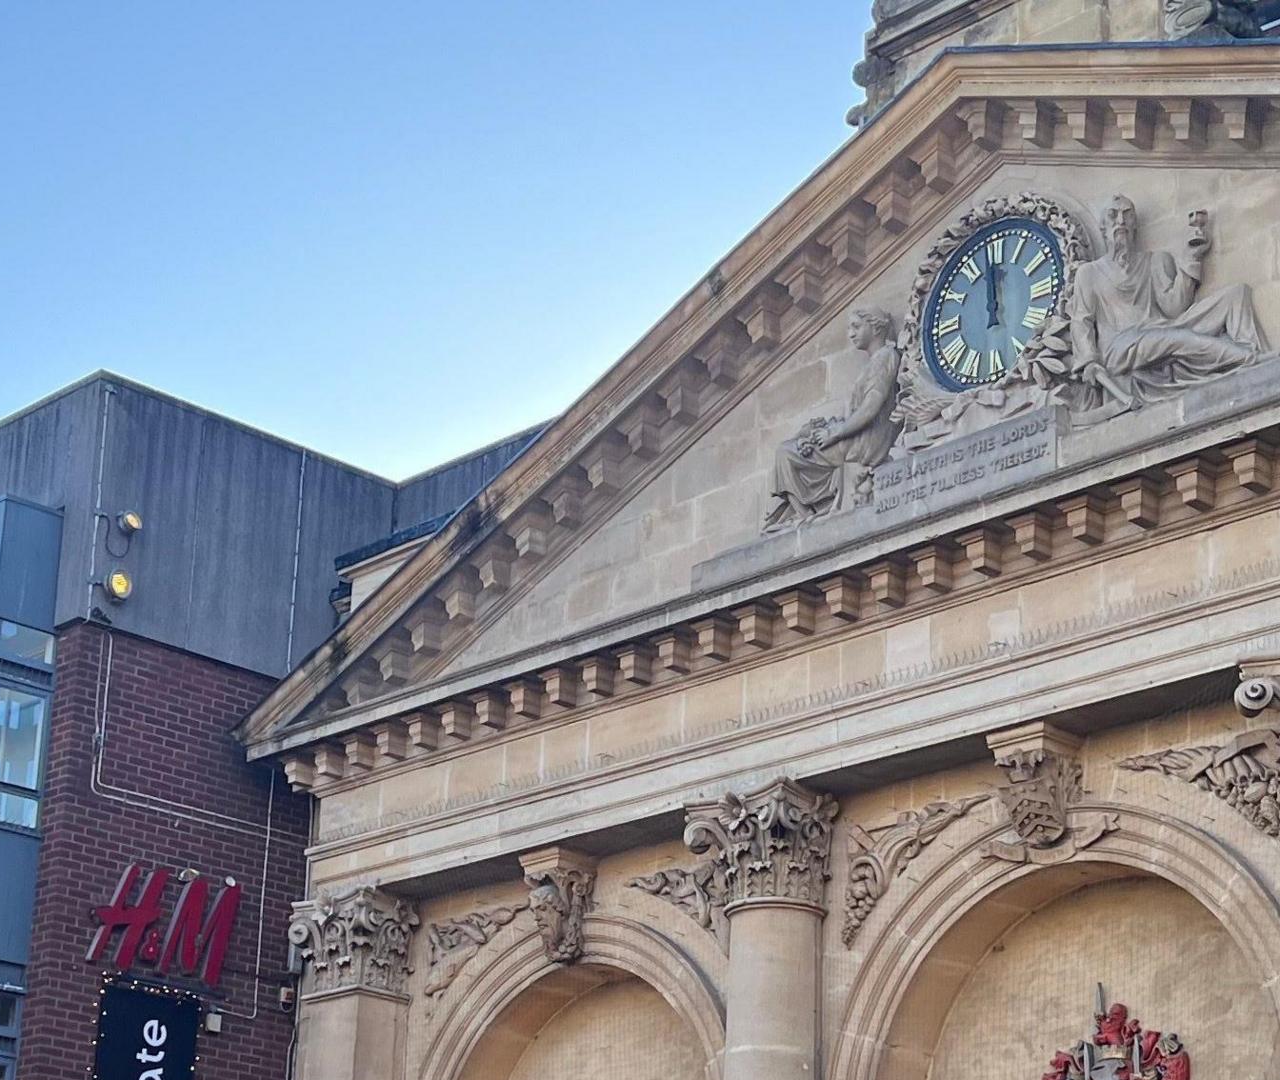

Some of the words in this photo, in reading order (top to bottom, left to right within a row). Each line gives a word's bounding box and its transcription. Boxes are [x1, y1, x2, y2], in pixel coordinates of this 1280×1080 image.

[875, 496, 900, 515] AND
[902, 485, 927, 505] THE
[930, 465, 985, 493] FULNESS
[877, 470, 902, 491] THE
[951, 448, 964, 464] IS
[969, 437, 996, 456] THE
[85, 862, 242, 986] H&M
